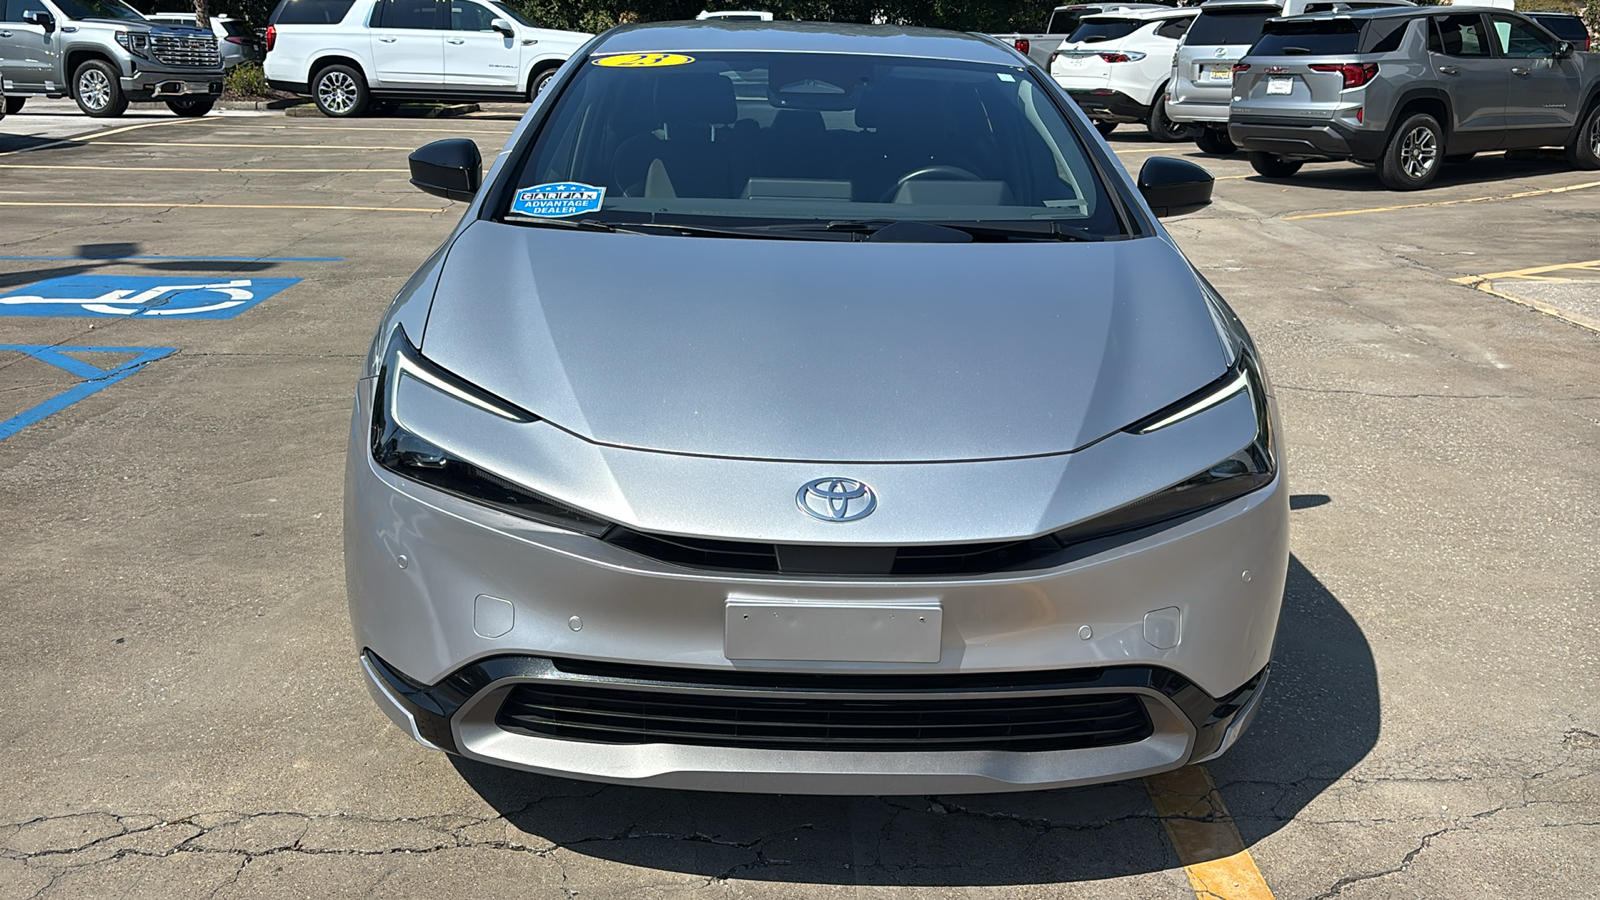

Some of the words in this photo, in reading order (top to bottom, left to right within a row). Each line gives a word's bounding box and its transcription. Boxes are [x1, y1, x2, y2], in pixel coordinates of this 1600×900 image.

[1263, 66, 1290, 74] GMC
[521, 192, 597, 200] CARFAX
[524, 200, 589, 208] ADVANTAGE
